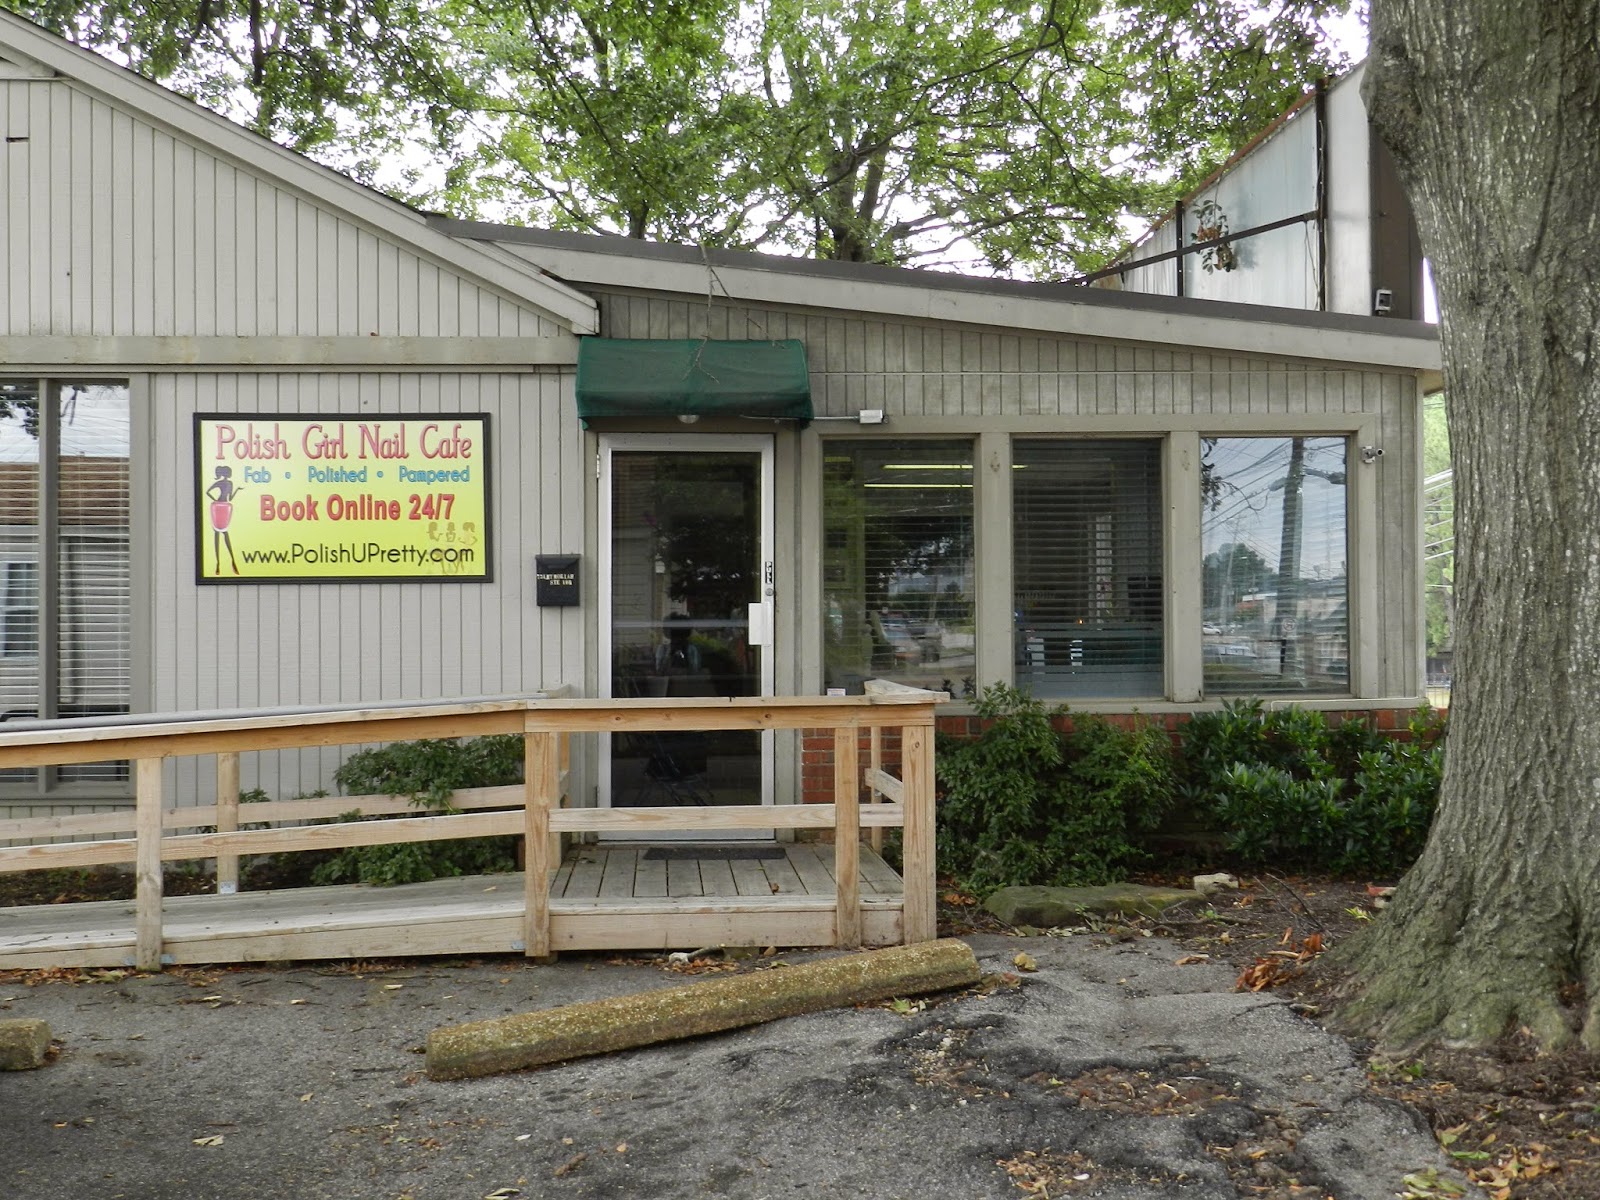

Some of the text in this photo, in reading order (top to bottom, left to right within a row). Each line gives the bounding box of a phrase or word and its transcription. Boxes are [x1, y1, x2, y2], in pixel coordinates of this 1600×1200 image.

[215, 423, 472, 459] Polish Girl Nail Cafe
[244, 465, 470, 485] Fab Polished Pampered
[260, 493, 455, 521] Book Online 24/7
[242, 543, 474, 566] www.PolishUPretty.com
